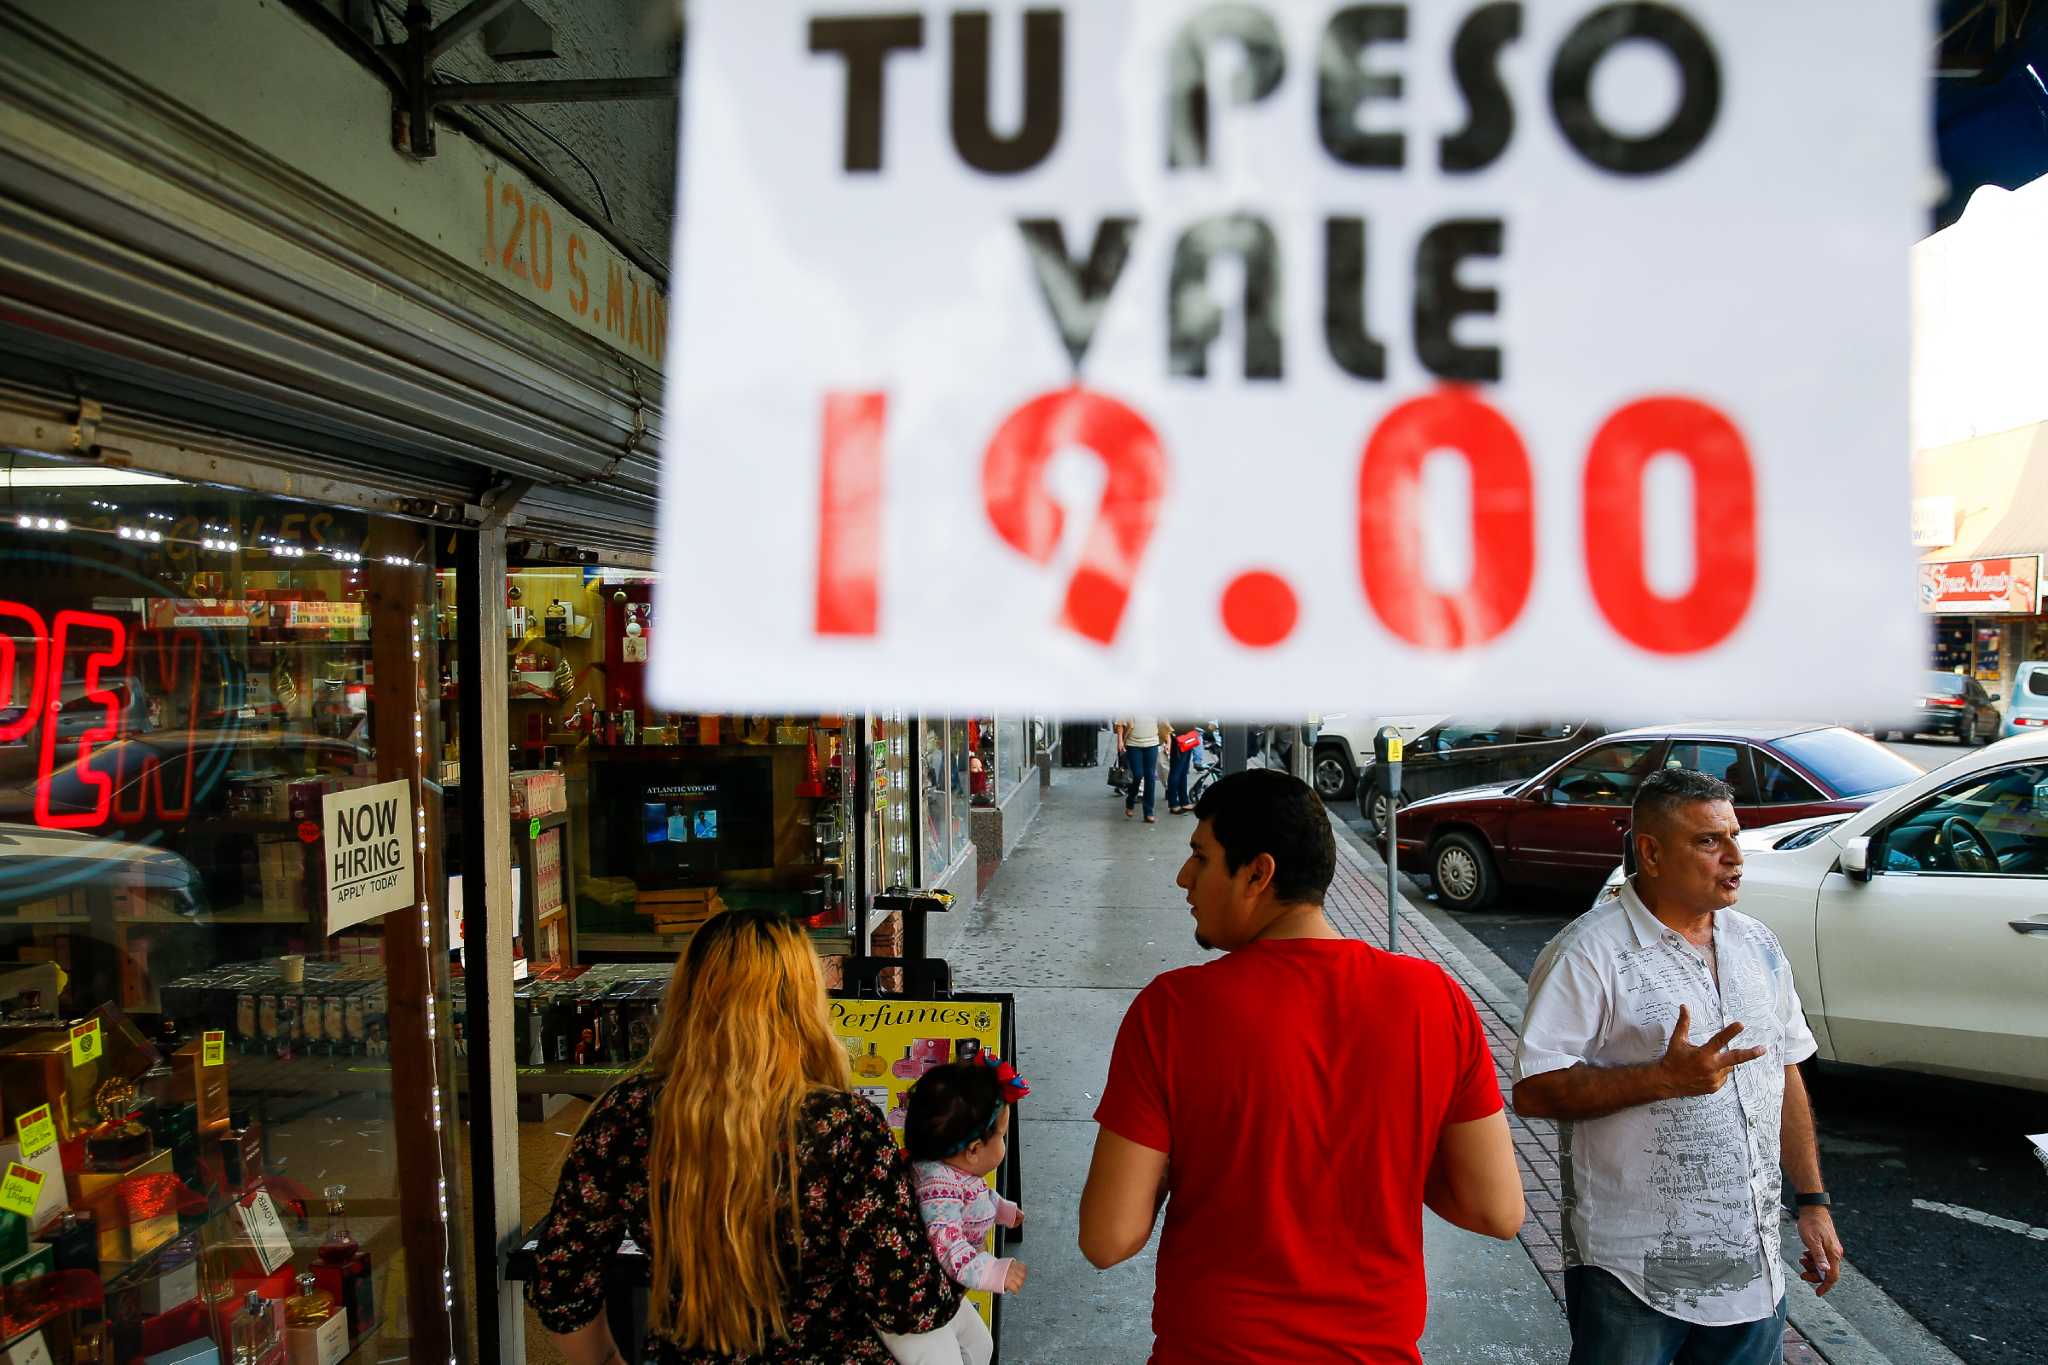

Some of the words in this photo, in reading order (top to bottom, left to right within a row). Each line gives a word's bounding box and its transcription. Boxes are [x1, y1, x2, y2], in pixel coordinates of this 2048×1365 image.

[806, 9, 1065, 175] TU
[1164, 1, 1724, 177] PESO
[482, 174, 553, 293] 120
[567, 232, 600, 324] S.
[1017, 214, 1504, 383] VALE
[811, 382, 1758, 656] 19.00
[647, 786, 686, 794] ATLANTIC
[337, 798, 398, 848] NOW
[334, 838, 401, 882] HIRING
[337, 880, 367, 904] APPLY
[370, 874, 399, 893] TODAY
[829, 1000, 971, 1032] Perfumes
